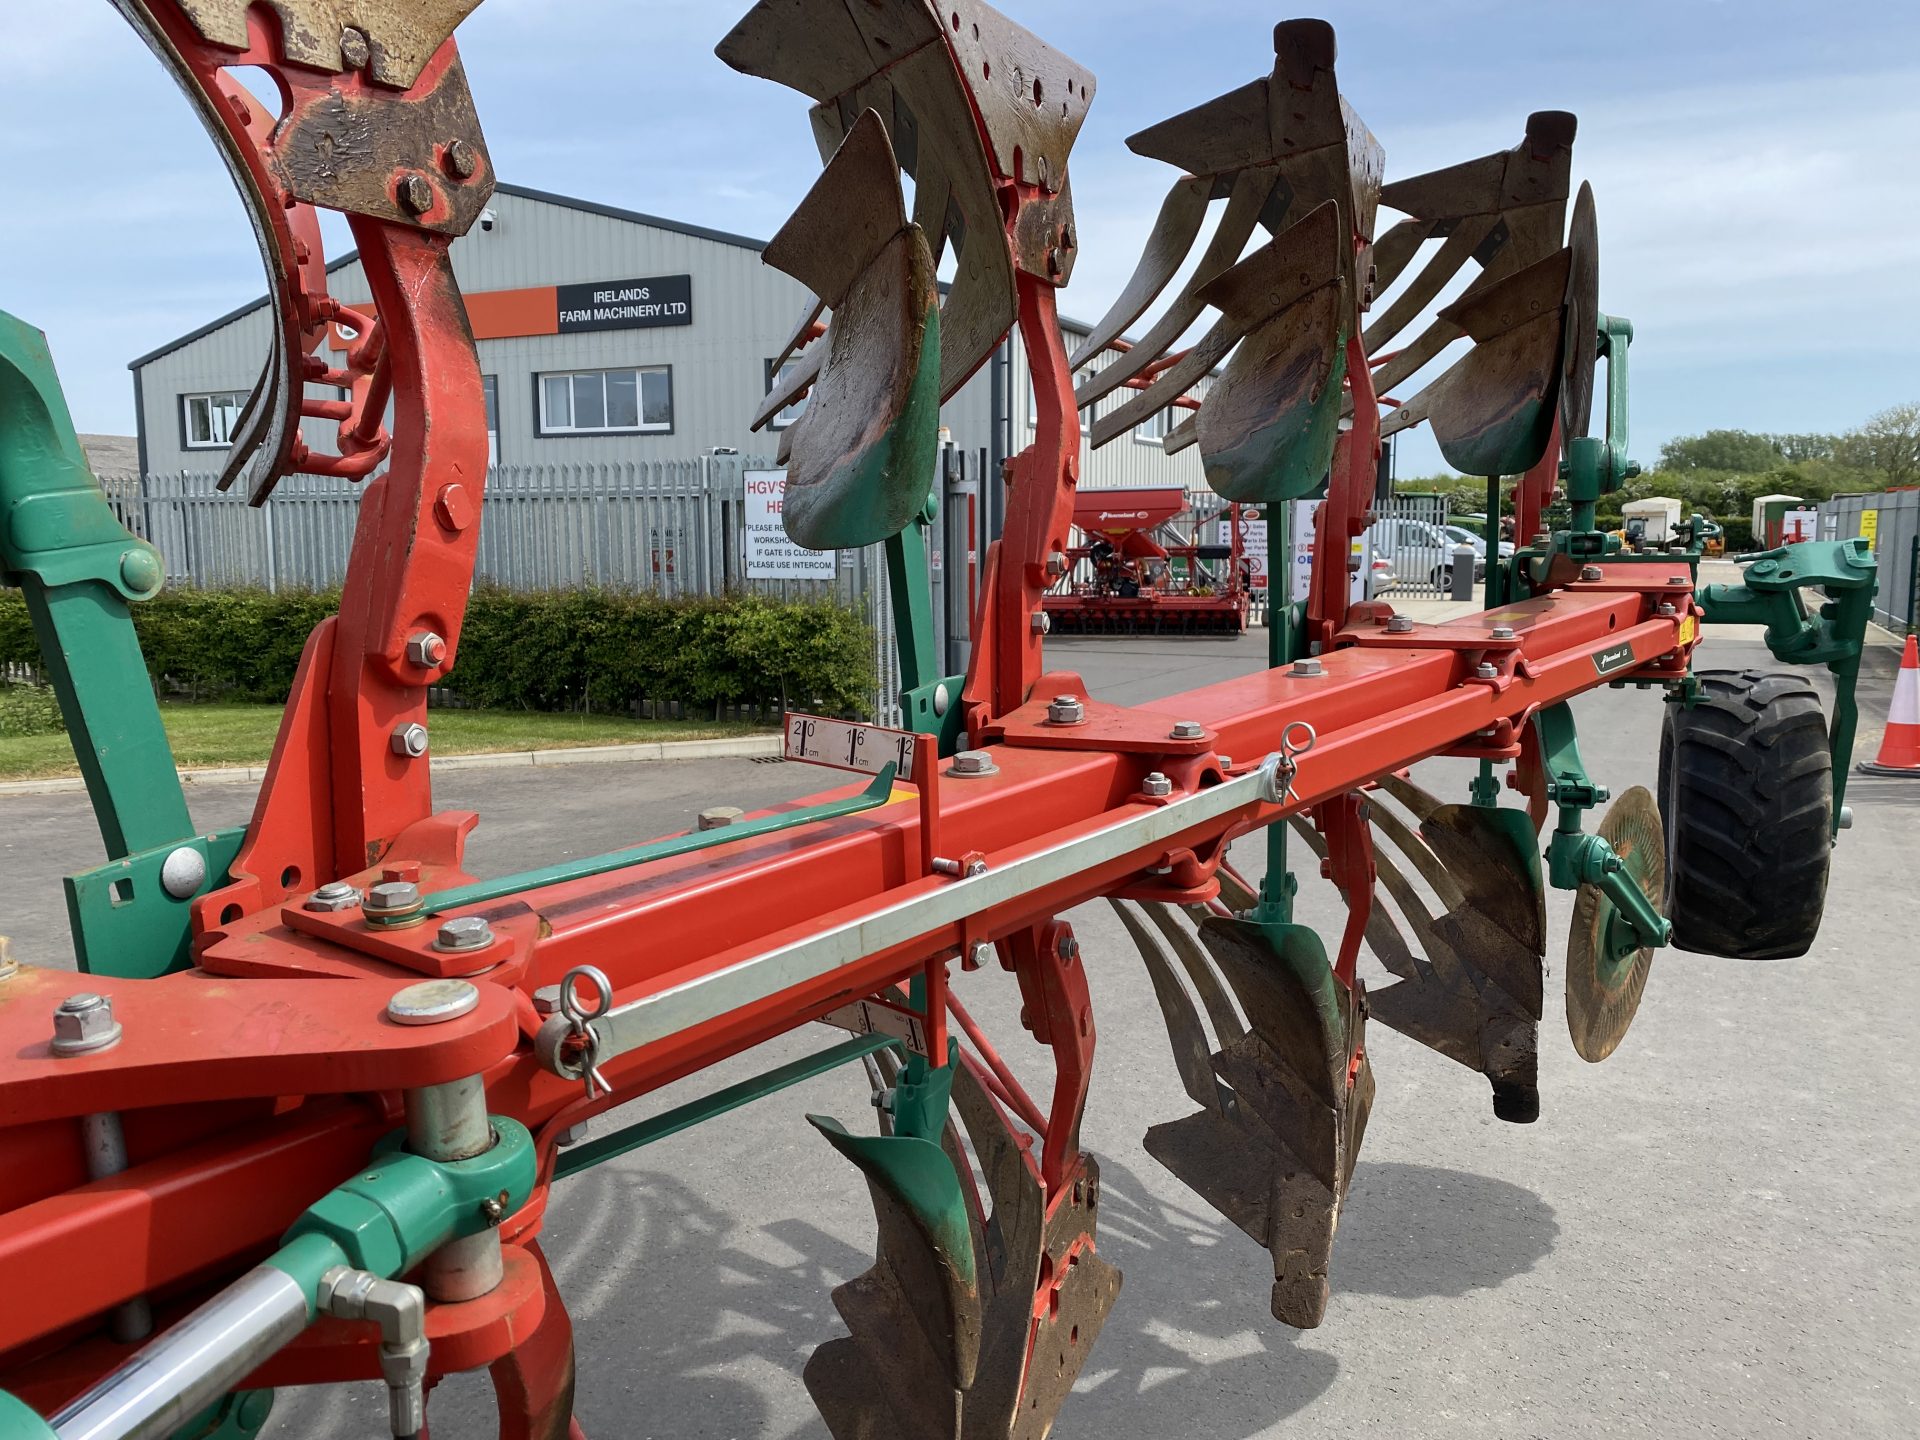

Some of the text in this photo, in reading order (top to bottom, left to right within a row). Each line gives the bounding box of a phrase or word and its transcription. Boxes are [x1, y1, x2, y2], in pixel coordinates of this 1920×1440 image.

[593, 287, 650, 303] IRELANDS
[559, 302, 687, 323] FARM MACHINERY LTD
[747, 480, 786, 495] HGV'S
[747, 524, 773, 532] PLEASE
[753, 536, 793, 544] WORKSHO
[756, 548, 824, 557] IF GATE IS CLOSED
[748, 561, 775, 569] PLEASE
[776, 561, 791, 569] USE
